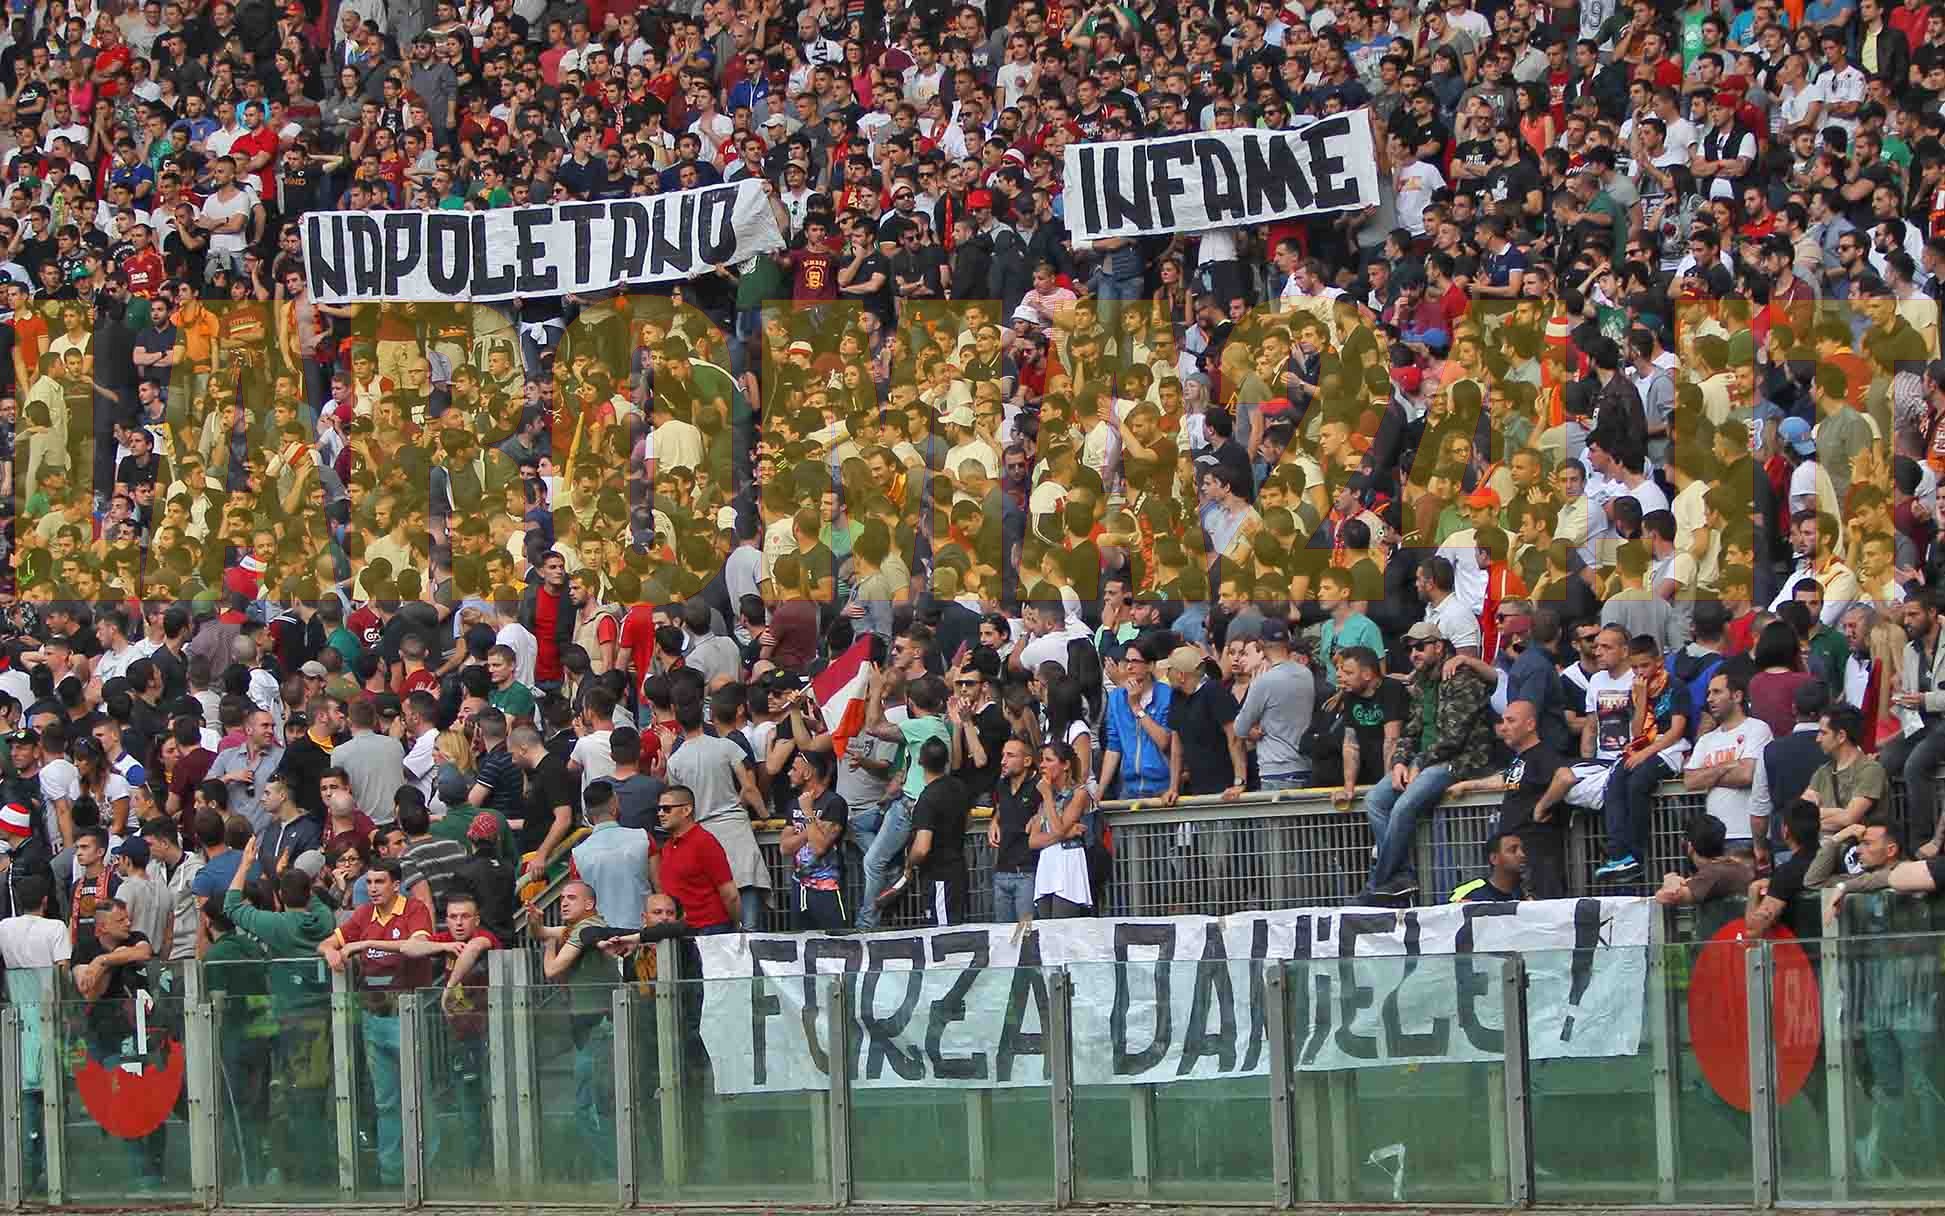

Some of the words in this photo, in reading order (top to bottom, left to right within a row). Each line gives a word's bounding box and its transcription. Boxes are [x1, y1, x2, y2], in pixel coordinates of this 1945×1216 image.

[1079, 117, 1360, 234] INFAME
[308, 185, 740, 297] NAPOLETANO
[750, 928, 1054, 1085] FORZA
